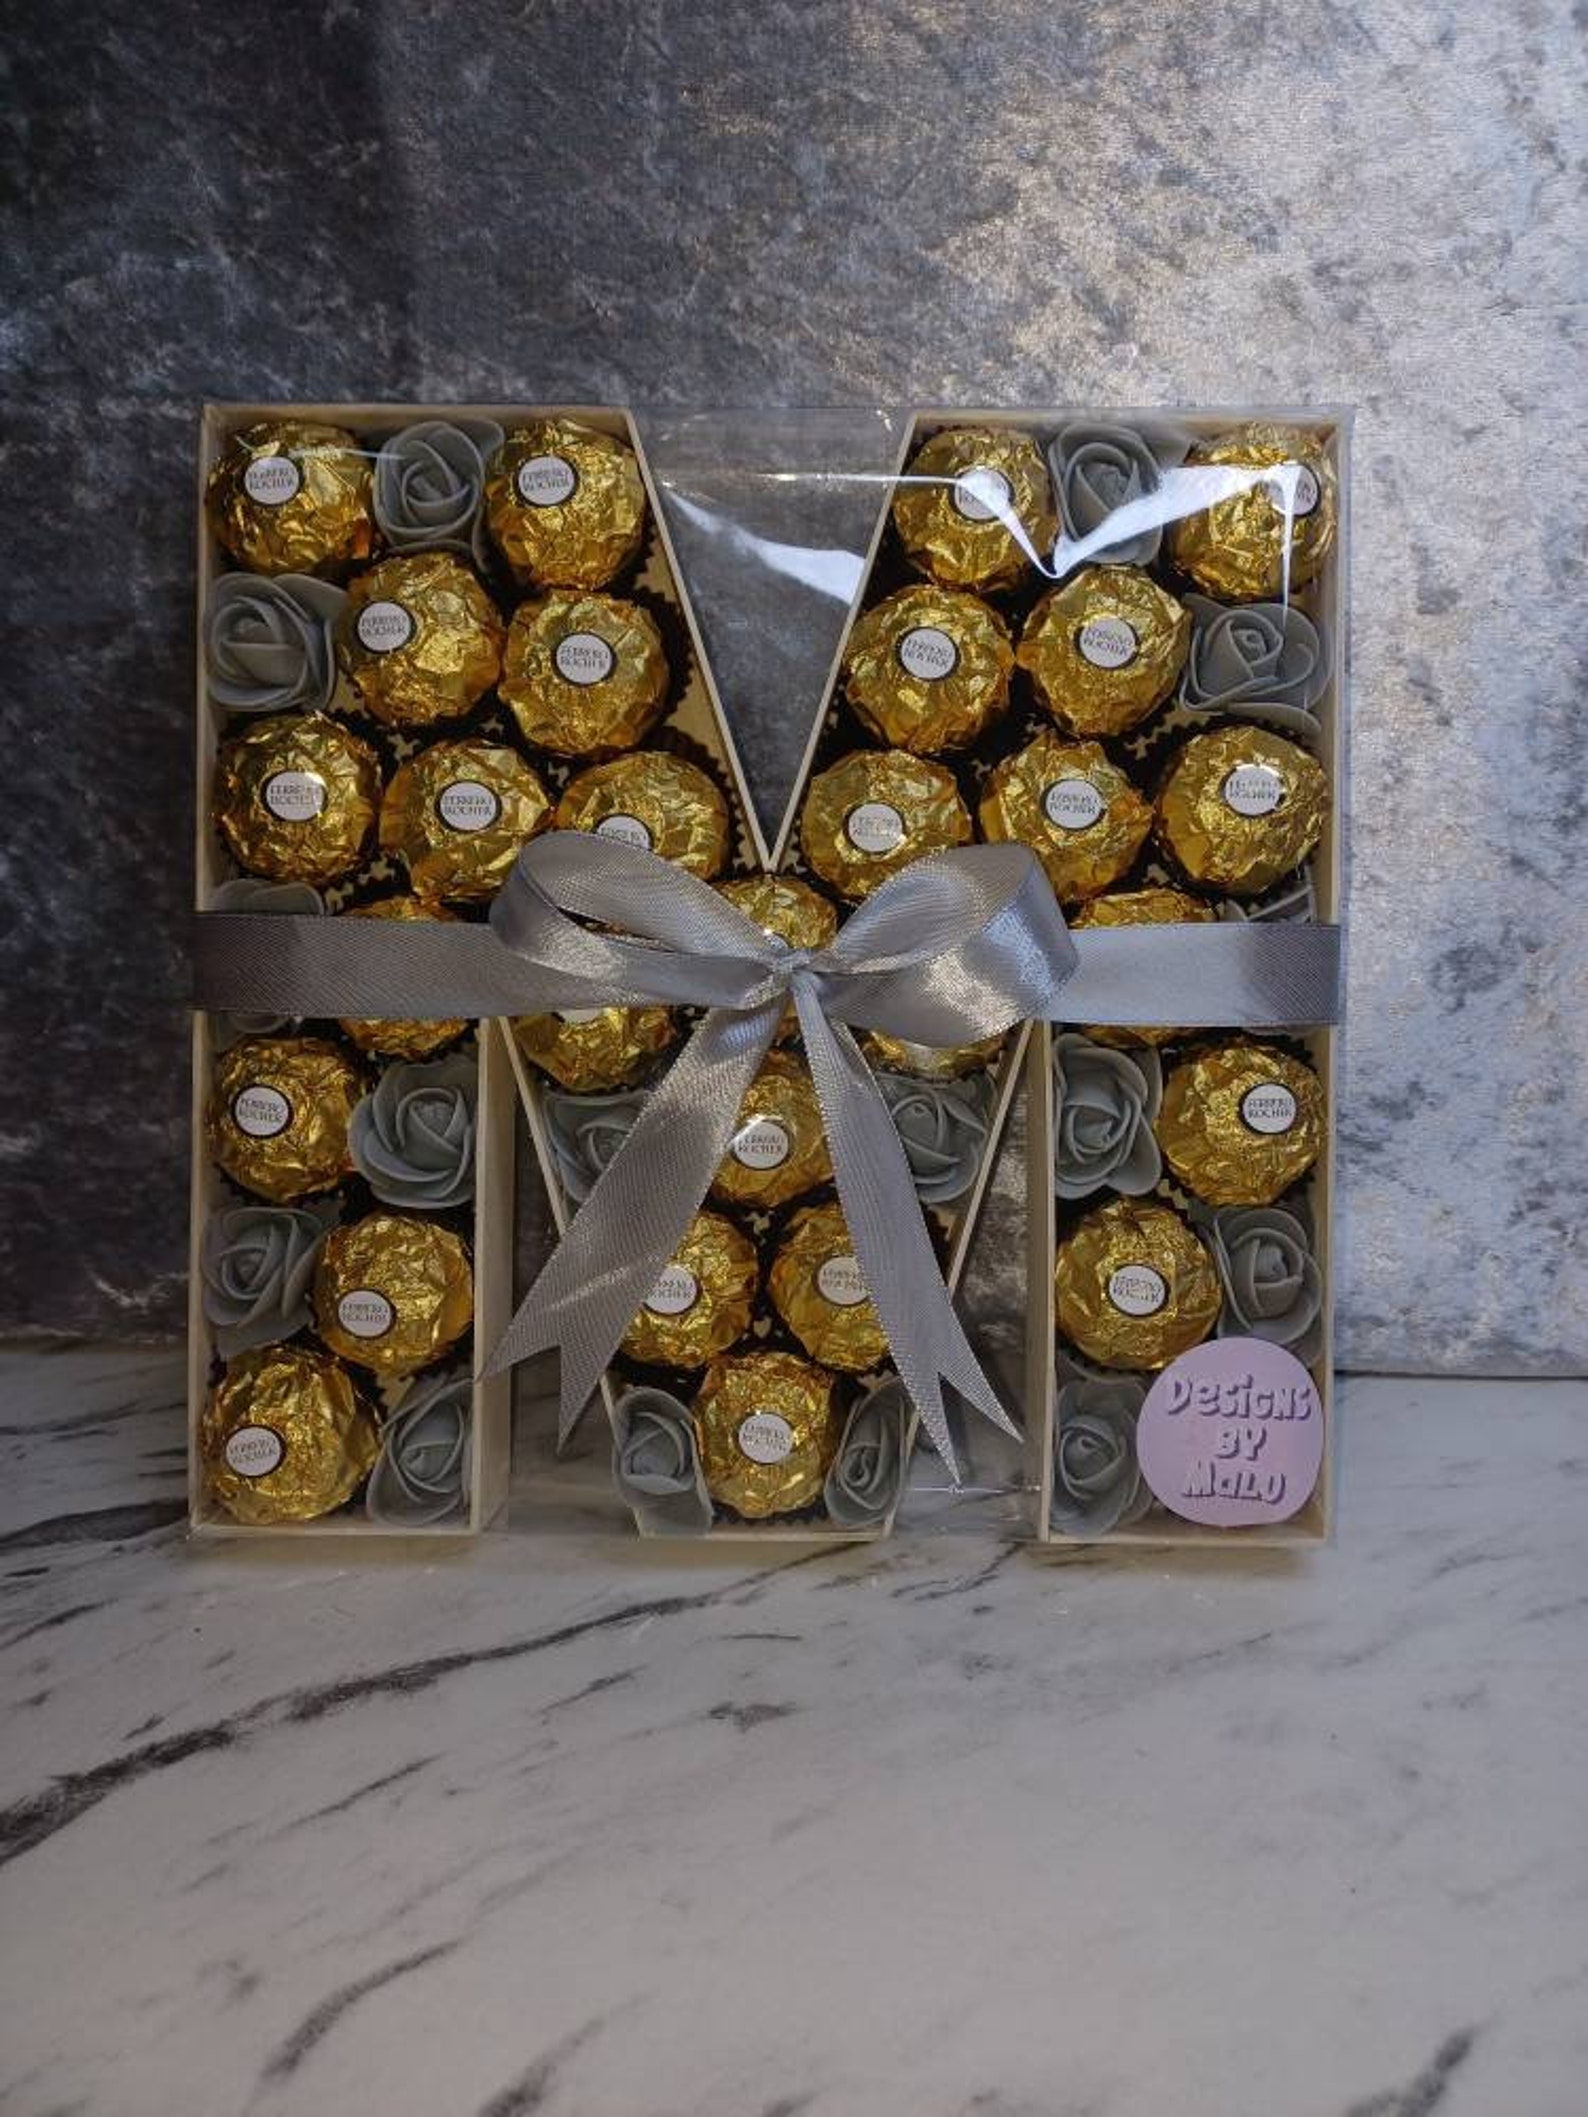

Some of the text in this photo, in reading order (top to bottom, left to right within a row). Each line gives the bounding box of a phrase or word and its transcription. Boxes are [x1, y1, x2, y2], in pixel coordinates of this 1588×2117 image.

[250, 478, 293, 490] ROCHER
[523, 478, 569, 492] ROCHER
[361, 625, 406, 636] ROCHER
[561, 656, 605, 669] ROCHER
[903, 648, 949, 666] ROCHER
[444, 795, 492, 806] FERRERO
[444, 806, 492, 817] ROCHER
[1049, 803, 1095, 814] ROCHER
[1247, 1098, 1292, 1108] FERRERO
[239, 1107, 283, 1122] ROCHER
[1247, 1108, 1292, 1119] ROCHER
[738, 1143, 783, 1154] ROCHER
[342, 1311, 387, 1322] ROCHER
[1215, 1426, 1267, 1461] BY
